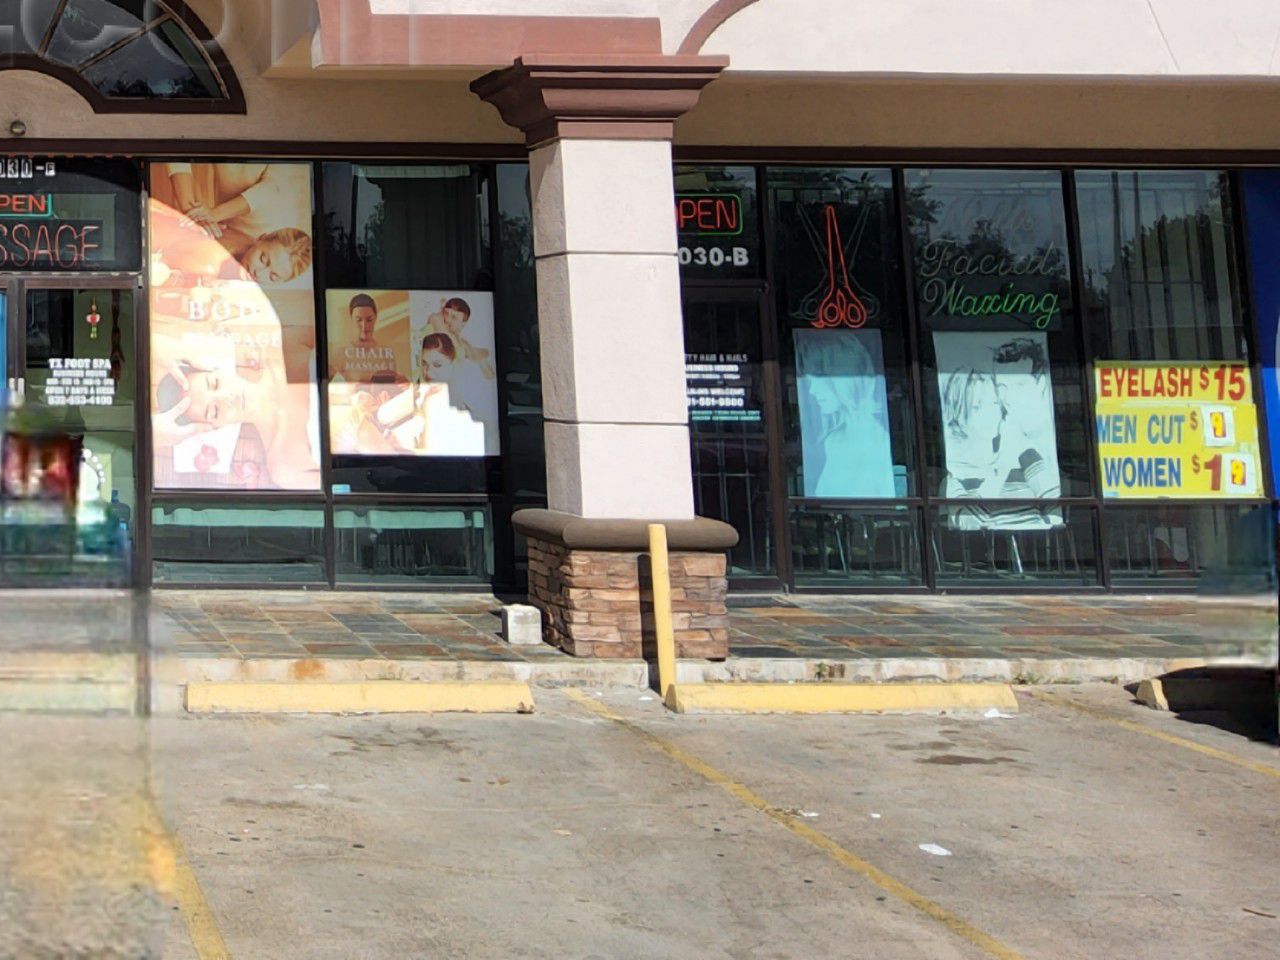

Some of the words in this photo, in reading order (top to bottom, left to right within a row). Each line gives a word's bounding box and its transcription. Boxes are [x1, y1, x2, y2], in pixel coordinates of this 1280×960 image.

[675, 199, 737, 229] PEN
[920, 239, 1061, 277] Facial
[188, 300, 276, 321] BOD
[923, 277, 1061, 330] Waxing
[344, 347, 395, 360] CHAIR
[1099, 367, 1193, 397] EYELASH
[1096, 414, 1137, 444] MEN
[1147, 414, 1185, 444] CUT
[1103, 456, 1182, 488] WOMEN
